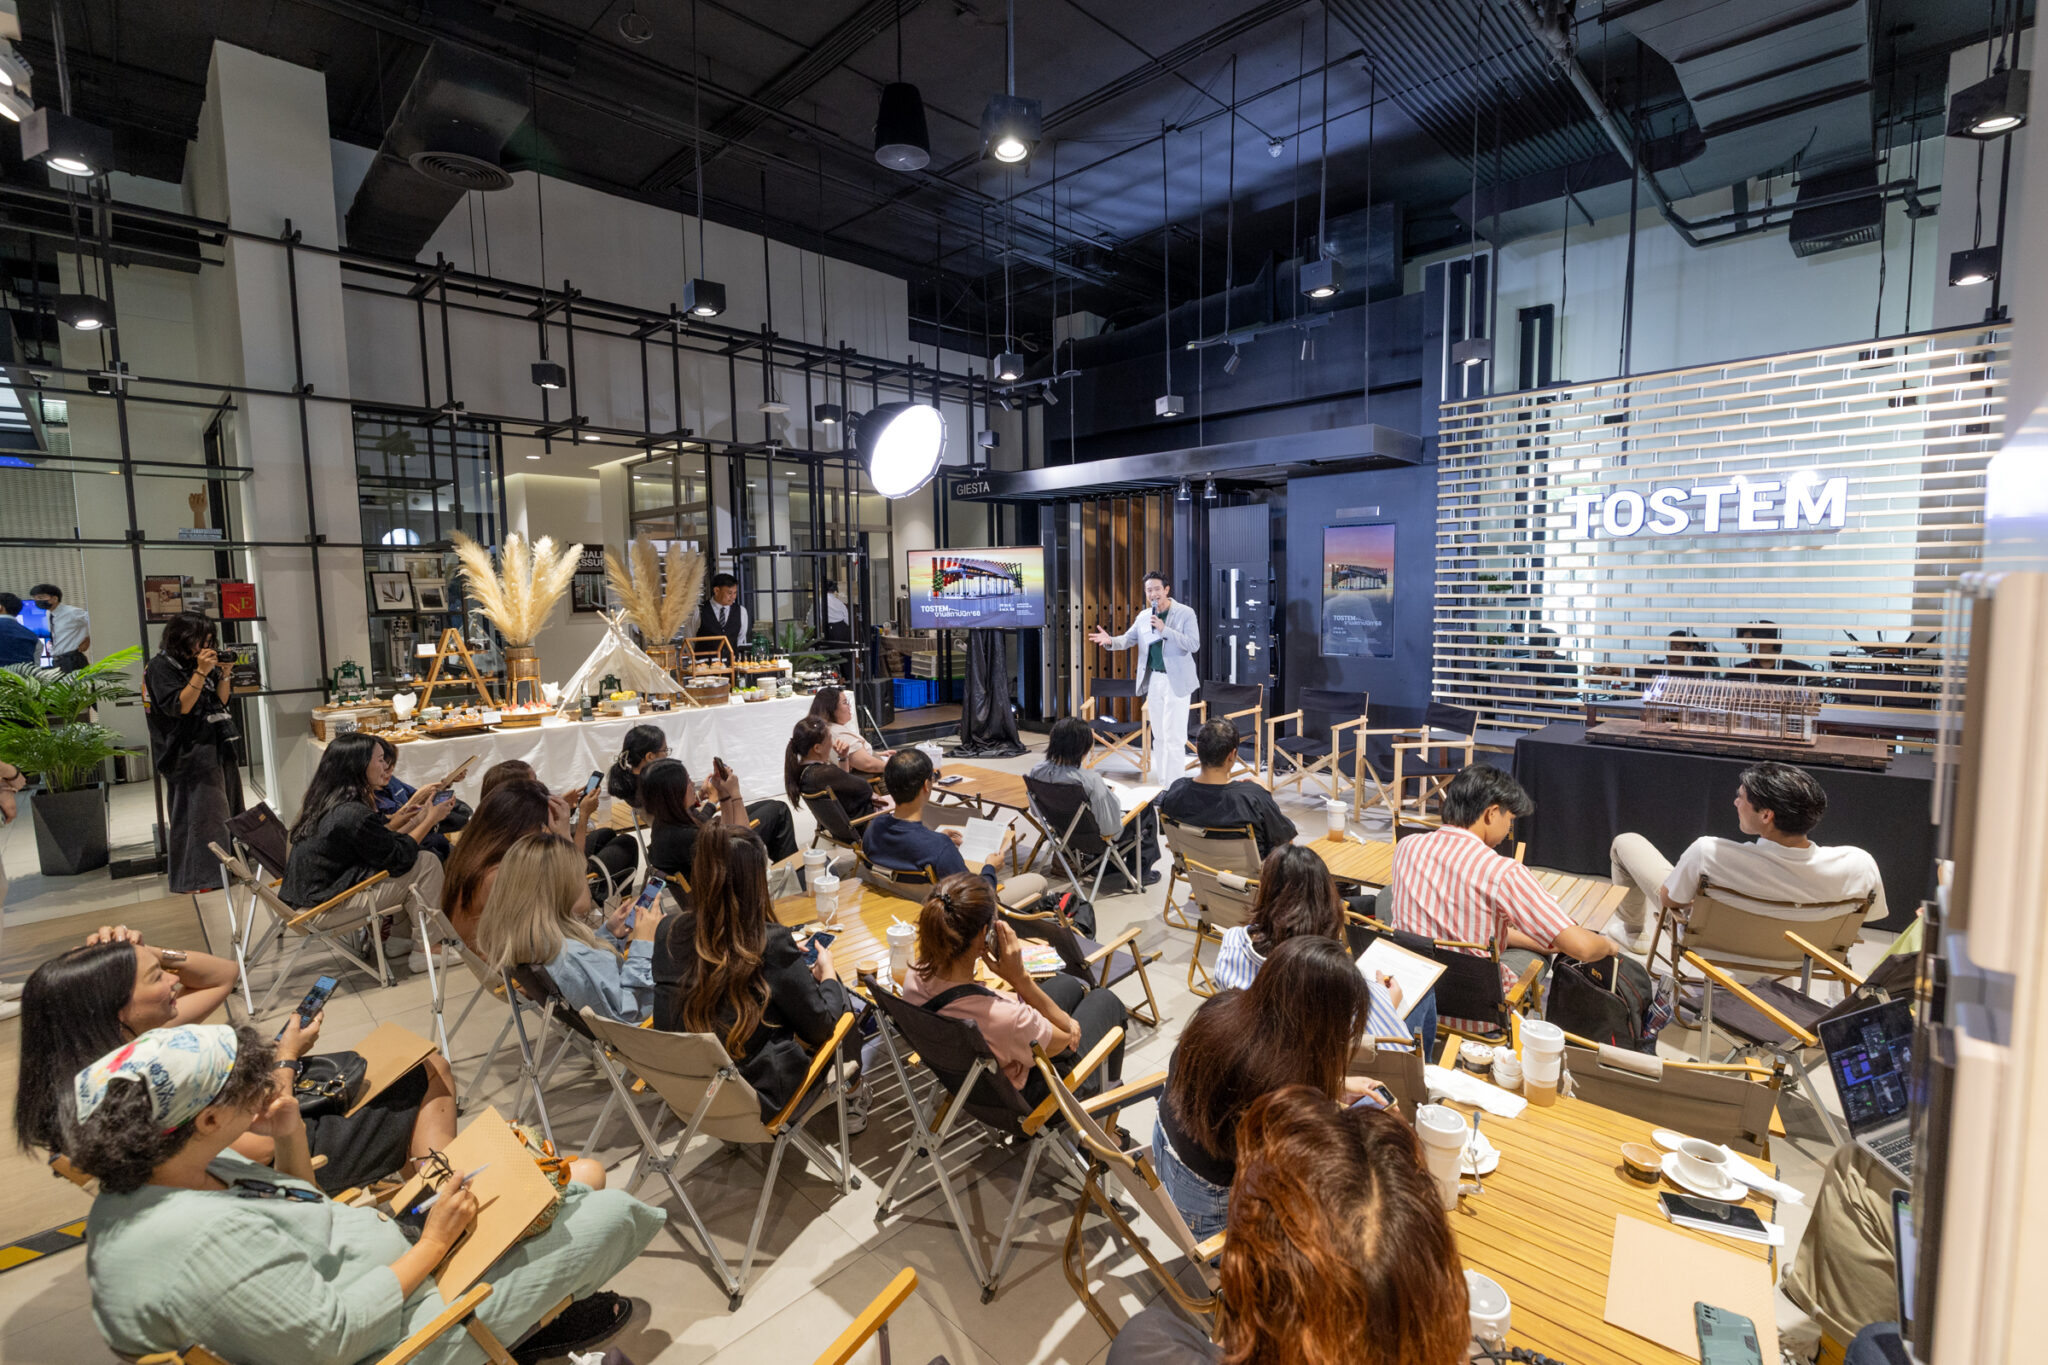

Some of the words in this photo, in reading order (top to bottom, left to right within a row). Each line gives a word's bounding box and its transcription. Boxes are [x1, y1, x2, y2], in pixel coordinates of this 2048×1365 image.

[956, 481, 990, 496] GIESTA
[1563, 476, 1849, 538] TOSTEM
[920, 605, 949, 613] TOSTEM
